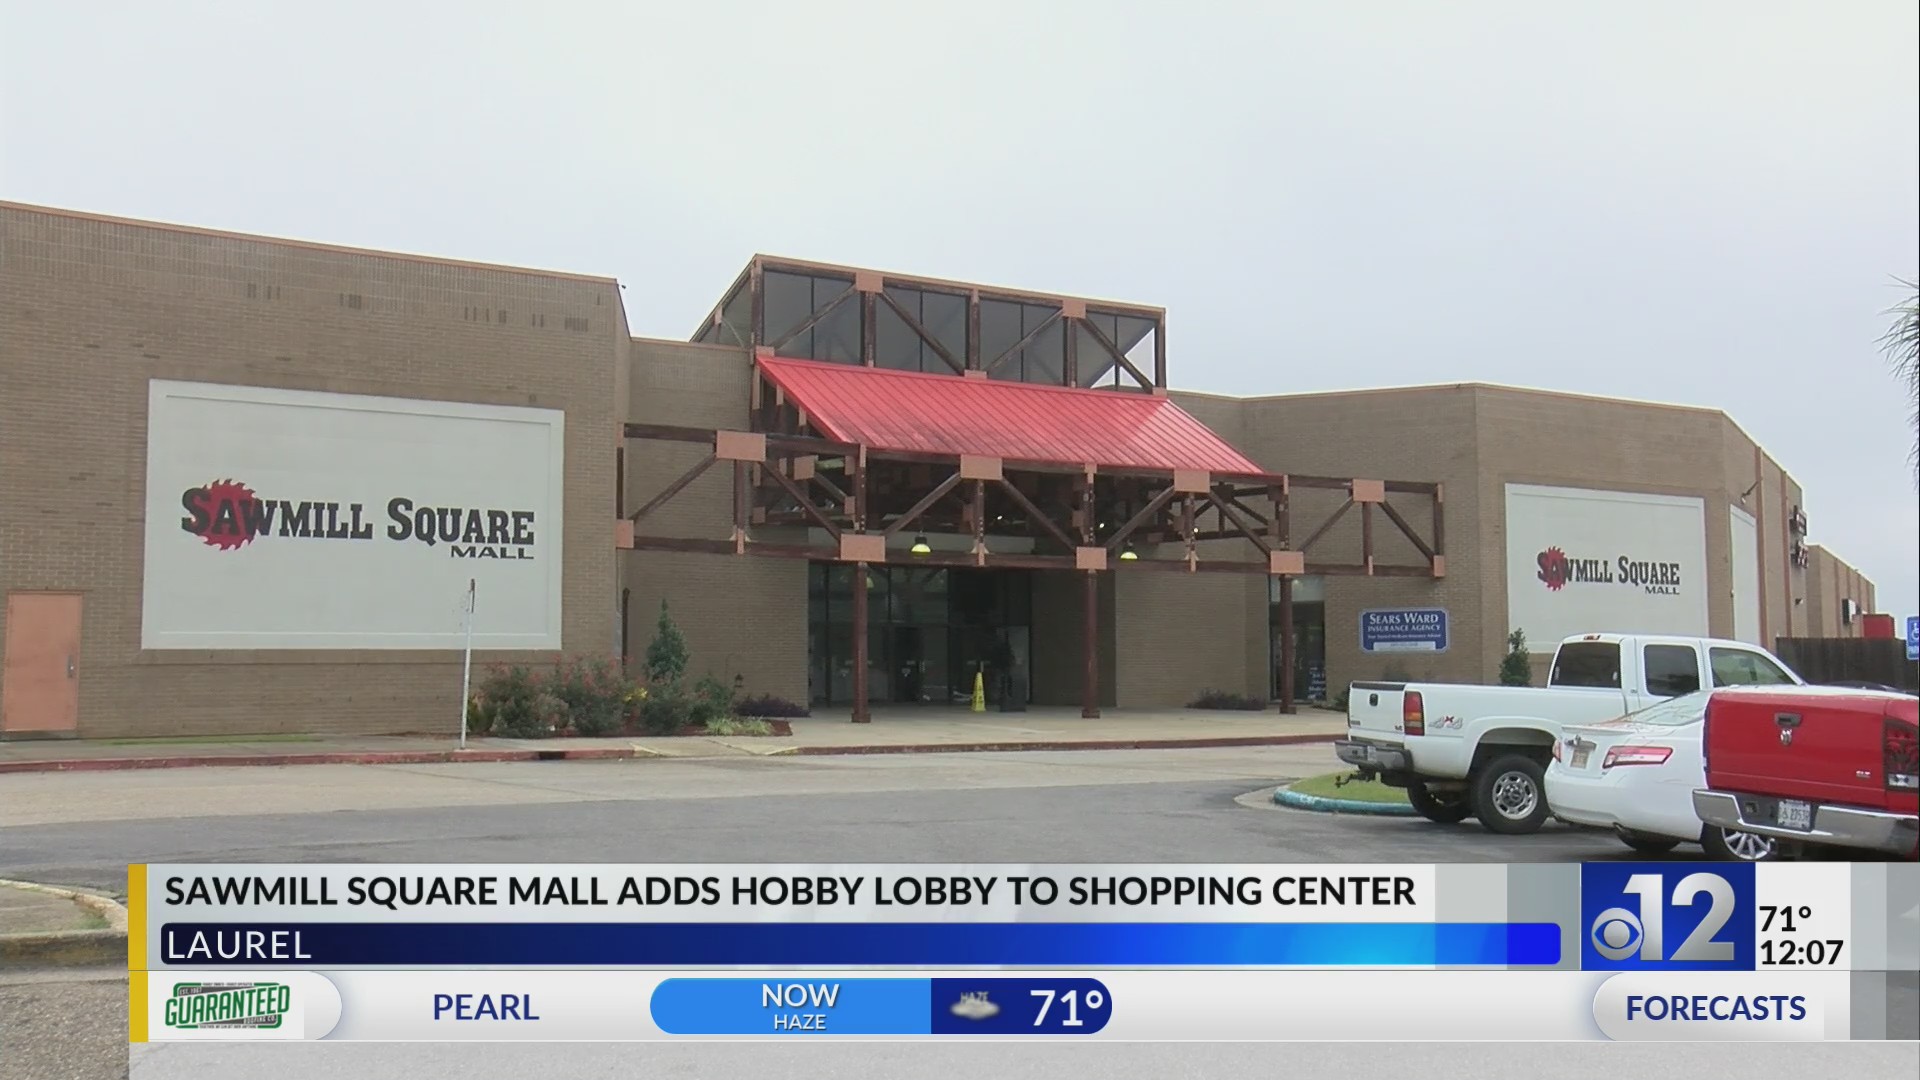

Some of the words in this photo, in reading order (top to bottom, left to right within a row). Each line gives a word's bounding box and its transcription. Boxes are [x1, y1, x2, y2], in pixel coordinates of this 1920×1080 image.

[181, 486, 374, 541] SAWMILL
[387, 497, 535, 547] SQUARE
[450, 545, 535, 560] MALL
[1536, 551, 1613, 583] SAWMILL
[1617, 555, 1681, 587] SQUARE
[1645, 585, 1681, 595] MALL
[1369, 613, 1401, 625] SEARS
[1404, 612, 1439, 624] WARD
